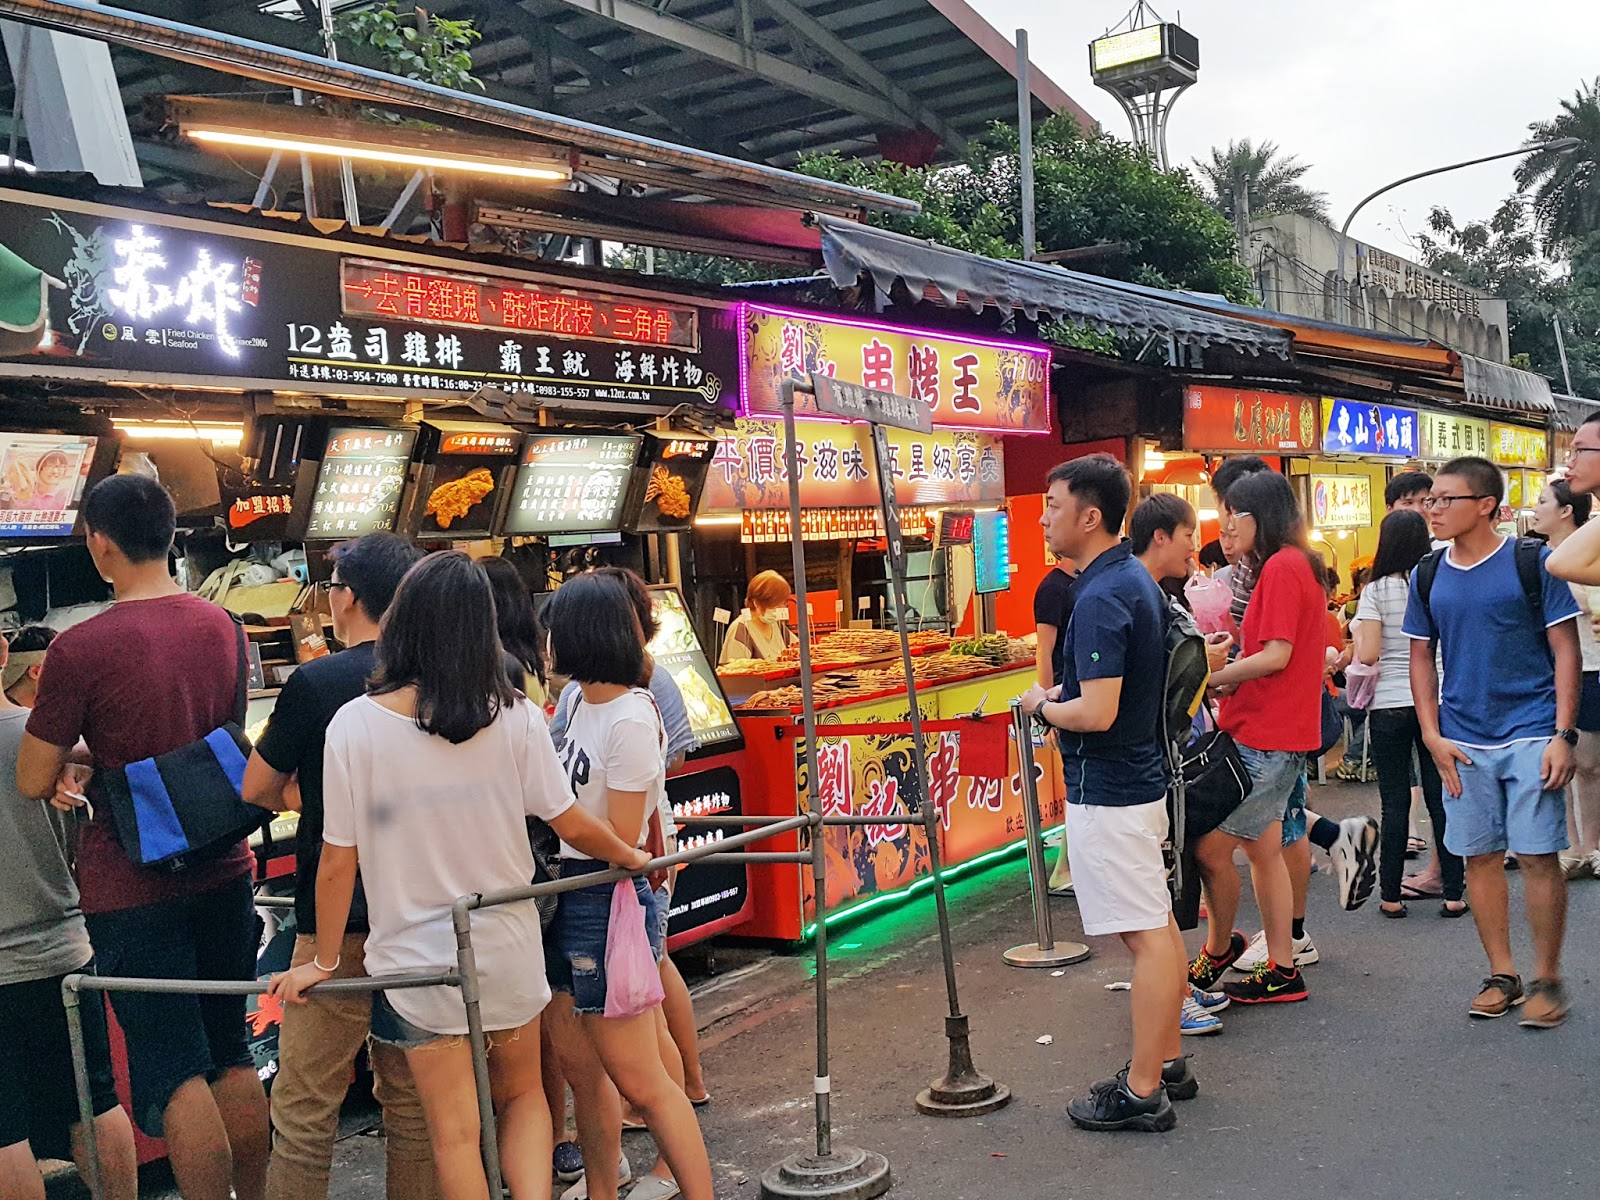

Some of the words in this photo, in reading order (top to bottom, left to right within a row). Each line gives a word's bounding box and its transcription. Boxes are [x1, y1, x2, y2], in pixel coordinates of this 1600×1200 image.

[121, 326, 161, 345] 風雲
[168, 328, 185, 340] Fried
[187, 331, 215, 342] Chicken
[168, 339, 198, 350] Seafood
[614, 350, 703, 388] 海鮮炸物
[1013, 355, 1044, 384] 1106
